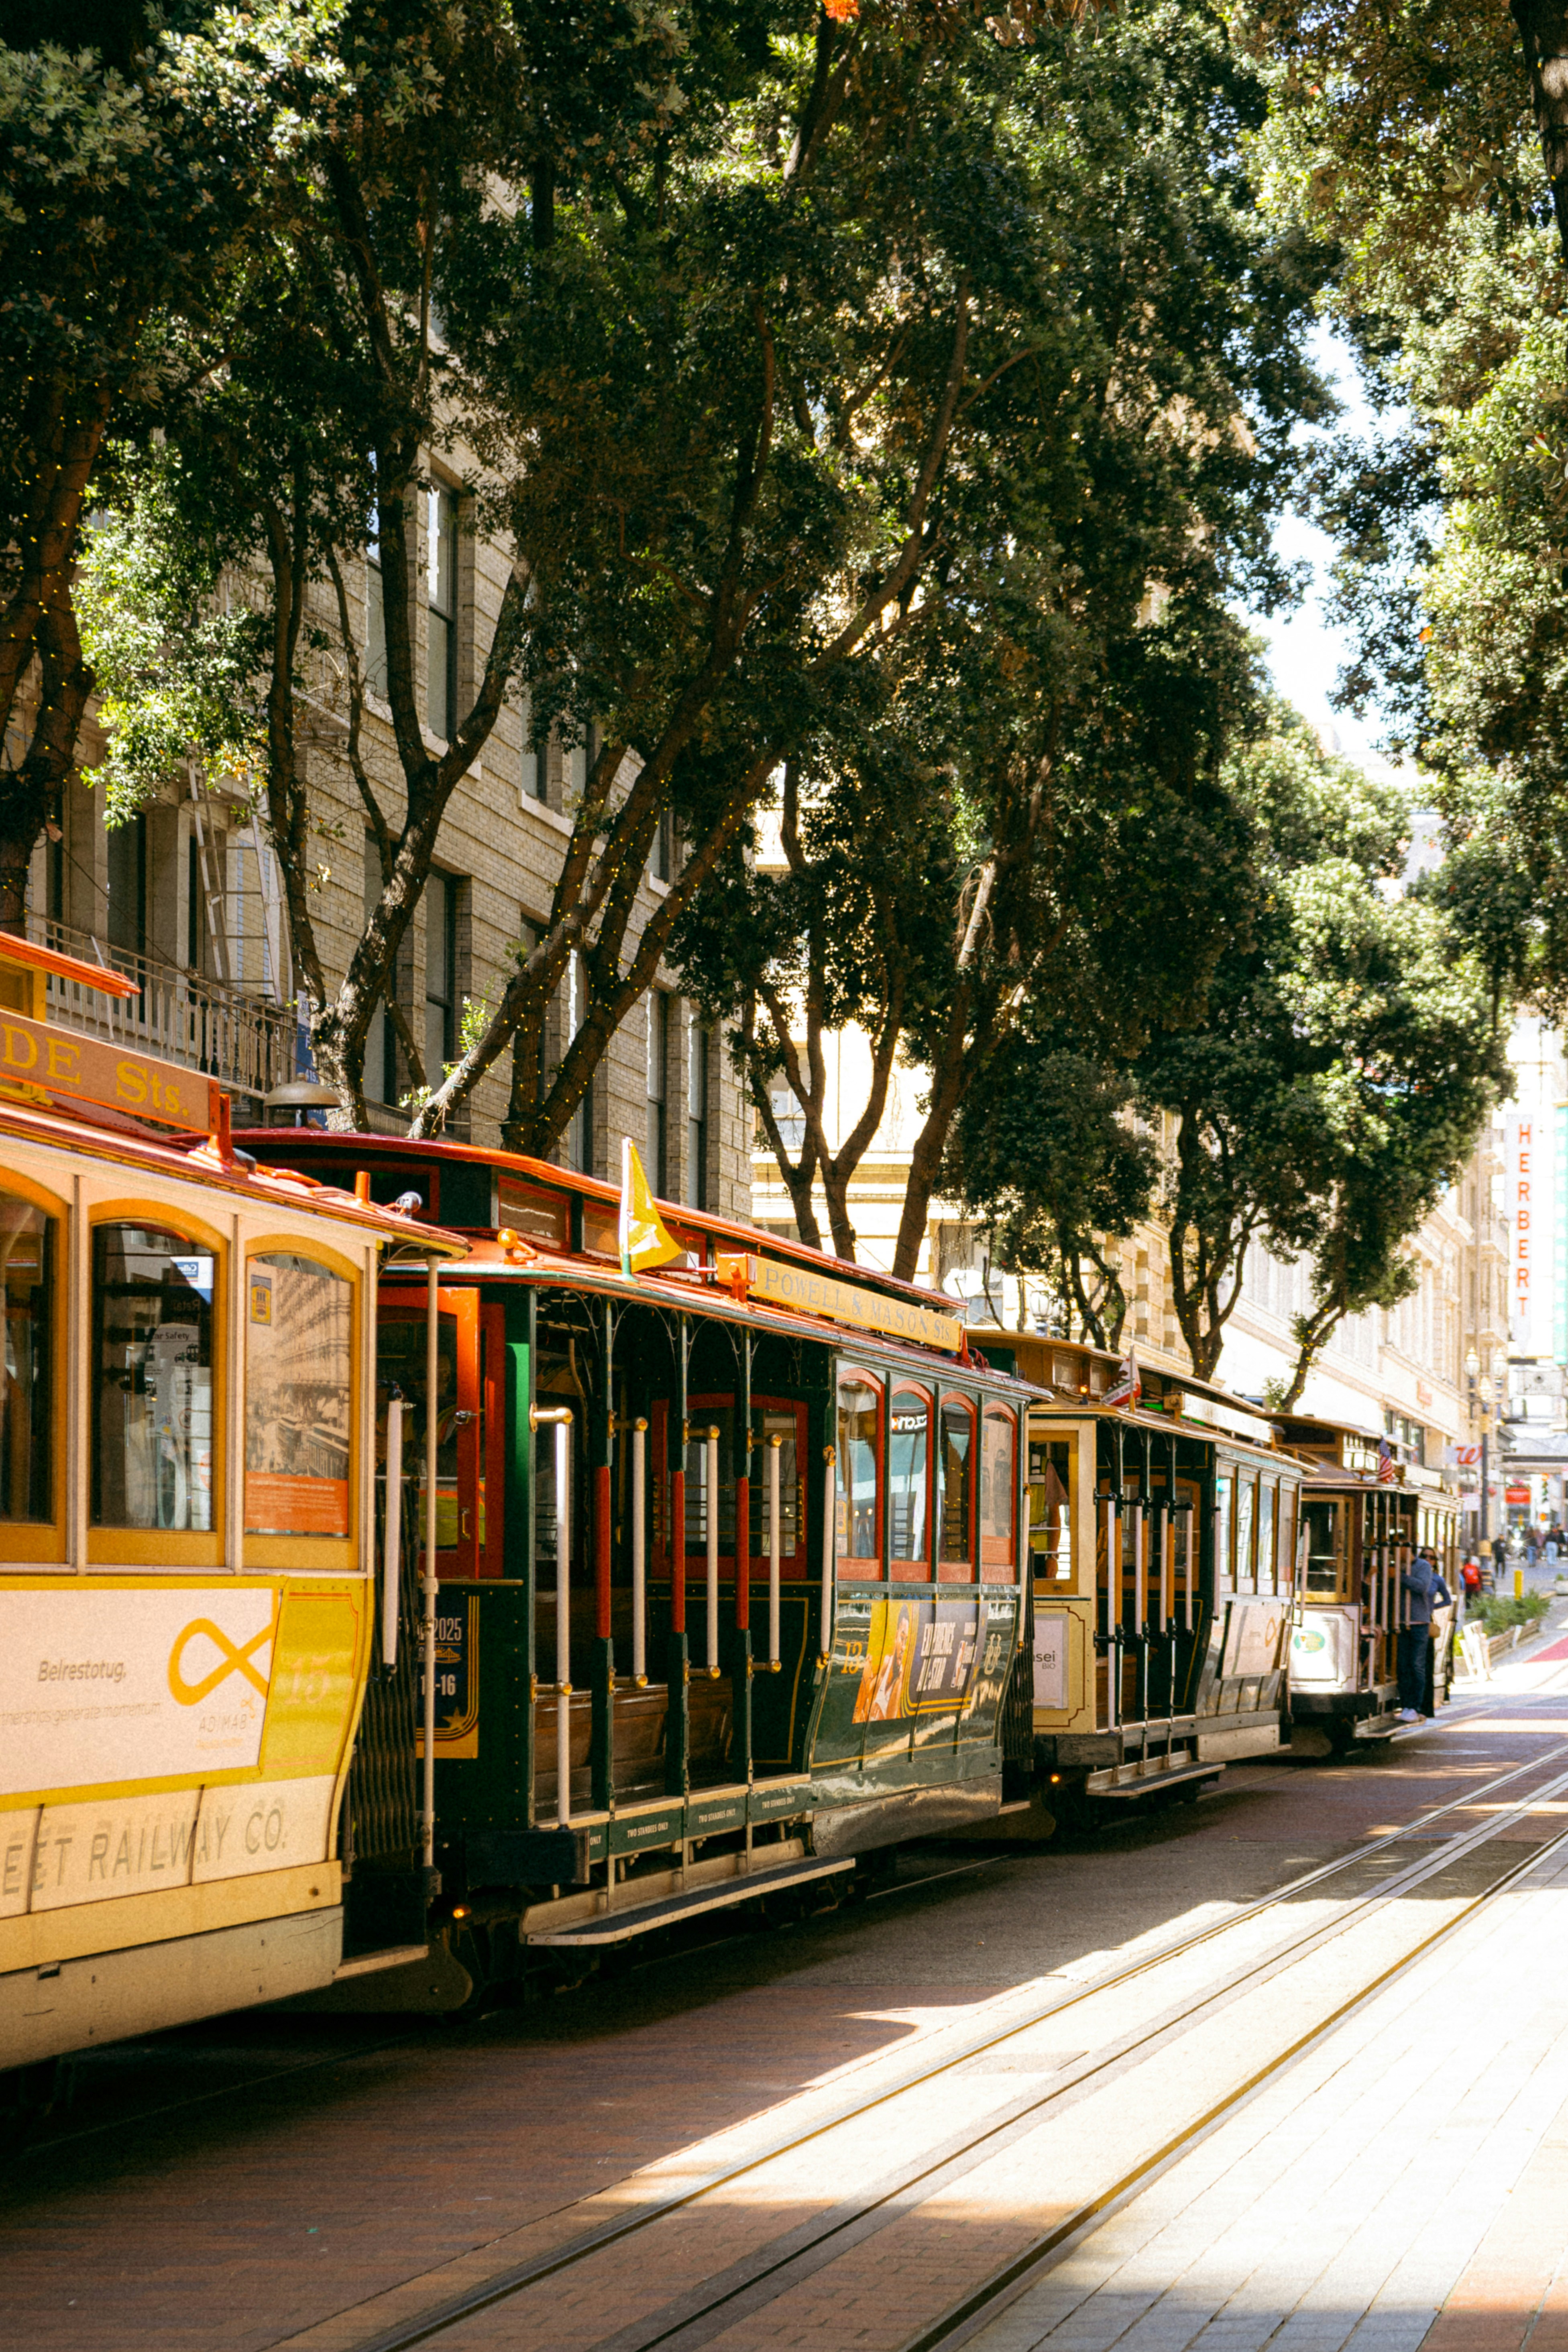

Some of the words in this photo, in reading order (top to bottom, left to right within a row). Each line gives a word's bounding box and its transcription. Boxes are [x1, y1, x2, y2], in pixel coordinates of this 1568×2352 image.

[116, 1061, 188, 1117] Sts.
[1516, 1123, 1532, 1316] HERBERT
[765, 1268, 845, 1312] POWELL
[852, 1293, 863, 1317] &
[870, 1300, 929, 1336] MASON
[934, 1319, 952, 1341] Sts.
[165, 1332, 189, 1341] Safety
[841, 1641, 863, 1674] 13
[1033, 1650, 1056, 1662] sei
[284, 1655, 330, 1705] 15
[420, 1674, 456, 1696] 1-16
[54, 1706, 100, 1726] generate
[199, 1713, 247, 1733] ADIMAB
[762, 1801, 770, 1810] TWO
[699, 1814, 707, 1824] TWO
[708, 1810, 725, 1822] STANDEES
[726, 1808, 736, 1817] ONLY
[627, 1828, 637, 1839] TWO
[637, 1824, 657, 1836] STANDEES
[658, 1821, 669, 1832] ONLY
[89, 1814, 231, 1882] RAILWAY
[590, 1835, 601, 1846] ONLY
